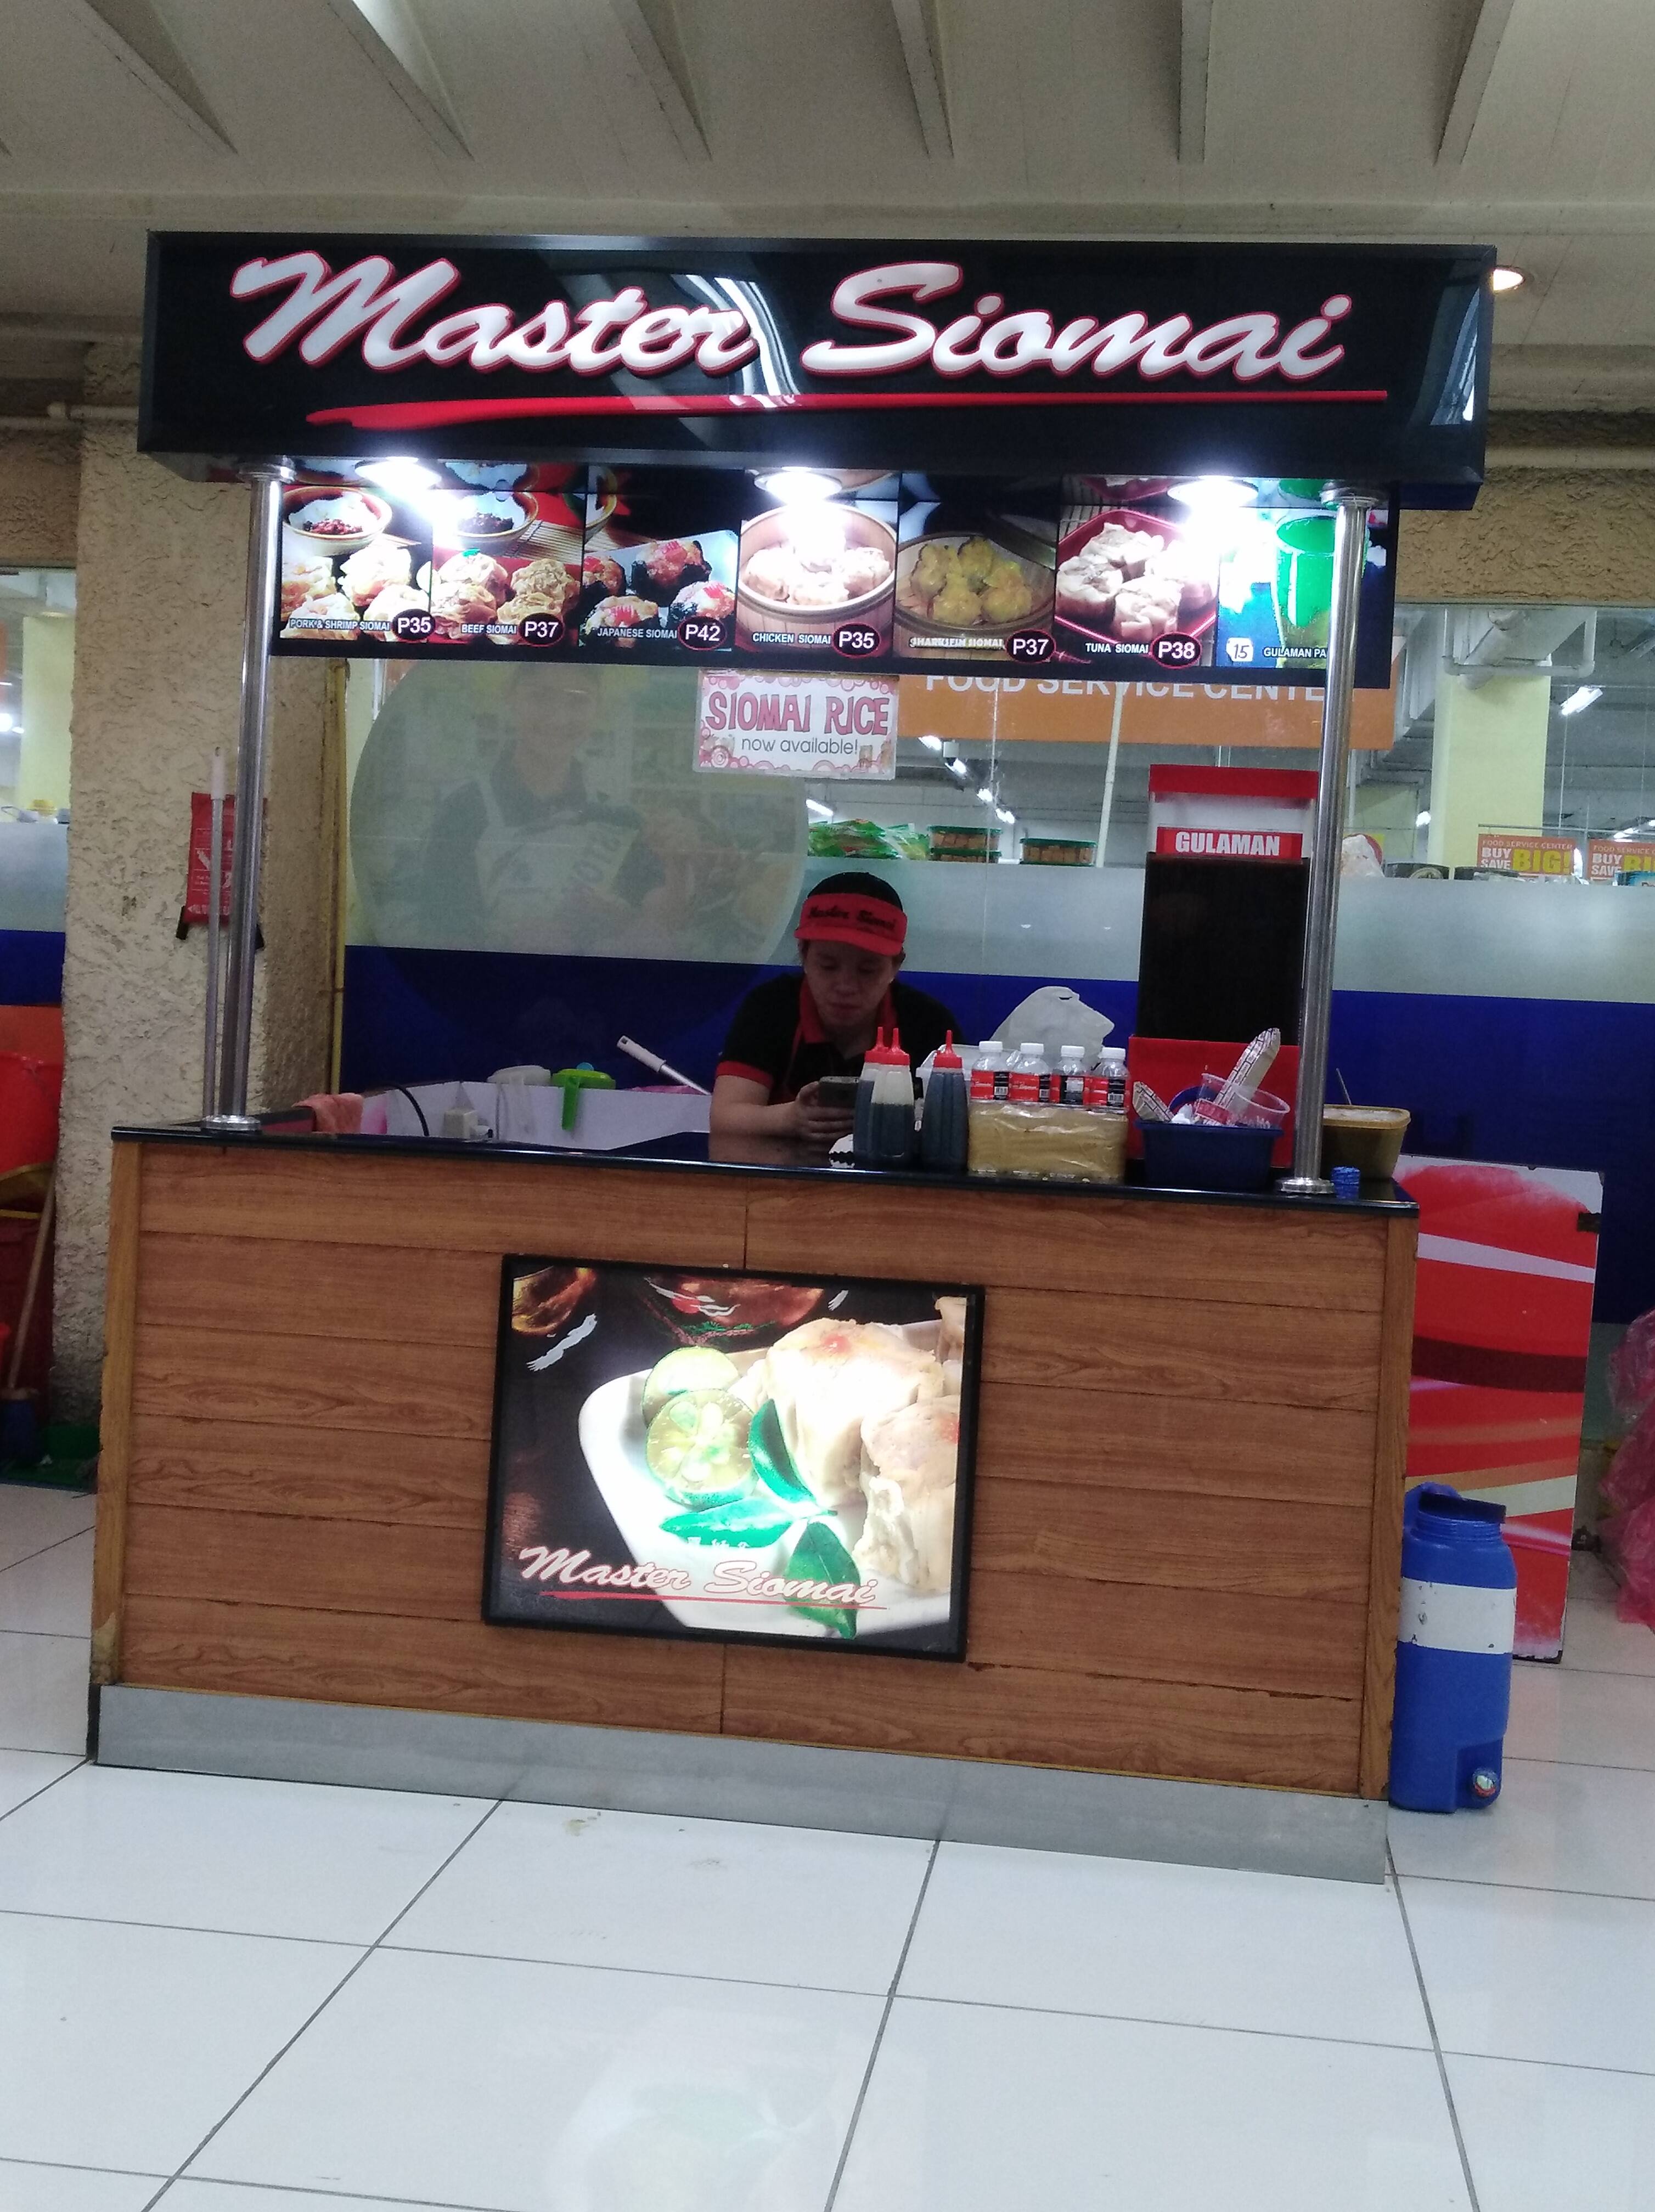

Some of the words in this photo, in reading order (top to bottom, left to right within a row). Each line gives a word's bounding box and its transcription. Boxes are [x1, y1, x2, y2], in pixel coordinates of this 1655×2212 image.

[230, 250, 758, 377] Master
[800, 260, 1353, 383] Siomai
[290, 618, 313, 629] PORK
[317, 620, 323, 629] &
[324, 620, 357, 630] SHRIMP
[359, 621, 390, 631] SIOMAI
[397, 617, 431, 634] P35
[461, 624, 485, 634] BEEF
[486, 625, 517, 634] SIOMAI
[524, 621, 559, 637] P37
[685, 624, 720, 641] P42
[597, 628, 644, 638] JAPANESE
[645, 629, 678, 639] SIOMAI
[752, 633, 794, 643] CHICKEN
[798, 634, 831, 644] SIOMAI
[838, 631, 875, 648] P35
[1012, 639, 1049, 656] P37
[1085, 643, 1111, 653] TUNA
[1114, 644, 1149, 654] SIOMAI
[1158, 641, 1195, 659] P38
[1233, 643, 1250, 659] 15
[1263, 647, 1312, 658] GULAMAN
[1314, 648, 1327, 658] PA
[1203, 683, 1325, 701] CENTE
[705, 691, 812, 733] SIOMAI
[824, 696, 890, 736] RICE
[741, 738, 775, 752] now
[780, 738, 858, 755] available!
[1175, 831, 1280, 856] GULAMAN
[1480, 859, 1511, 870] SAVE
[1482, 847, 1512, 859] BUY
[1512, 848, 1572, 874] BIG!
[1592, 853, 1622, 865] BUY
[1624, 854, 1655, 872] BI
[519, 1546, 691, 1590] Master
[703, 1560, 878, 1604] Siomai
